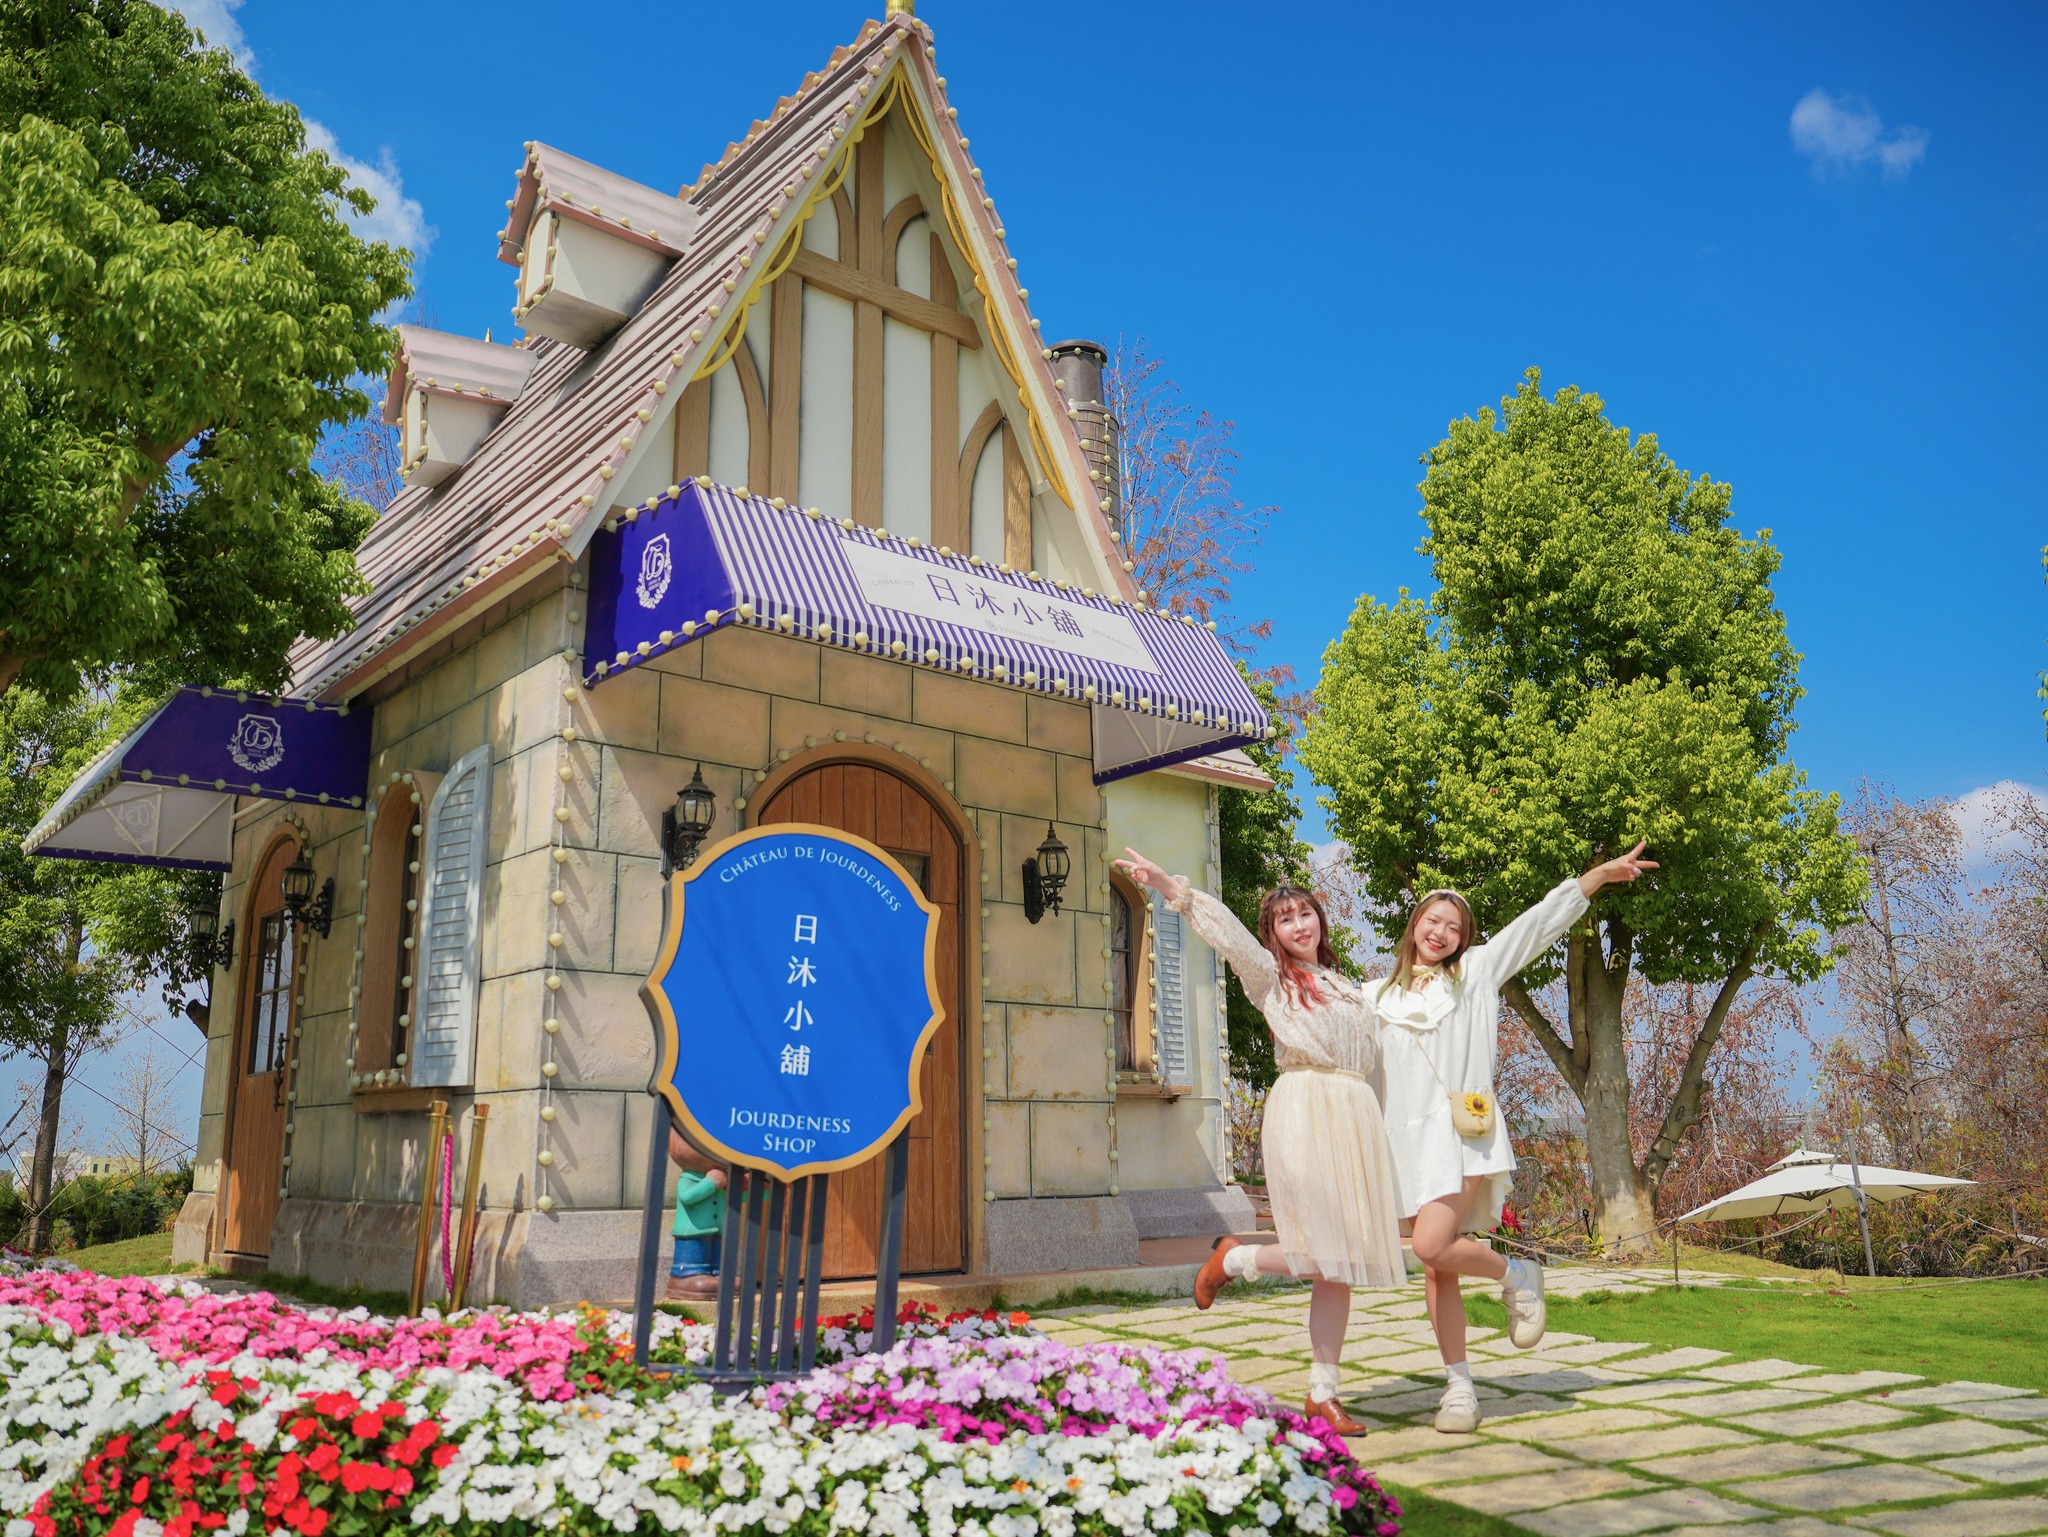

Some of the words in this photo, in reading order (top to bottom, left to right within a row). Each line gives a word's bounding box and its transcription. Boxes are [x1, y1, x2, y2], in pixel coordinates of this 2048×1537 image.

[926, 573, 1084, 638] 日沐小舖
[795, 846, 815, 859] DE
[819, 848, 902, 912] JOURDENESS
[779, 913, 818, 1076] 日沐小舖
[729, 1107, 851, 1134] JOURDENESS
[763, 1133, 817, 1154] SHOP
